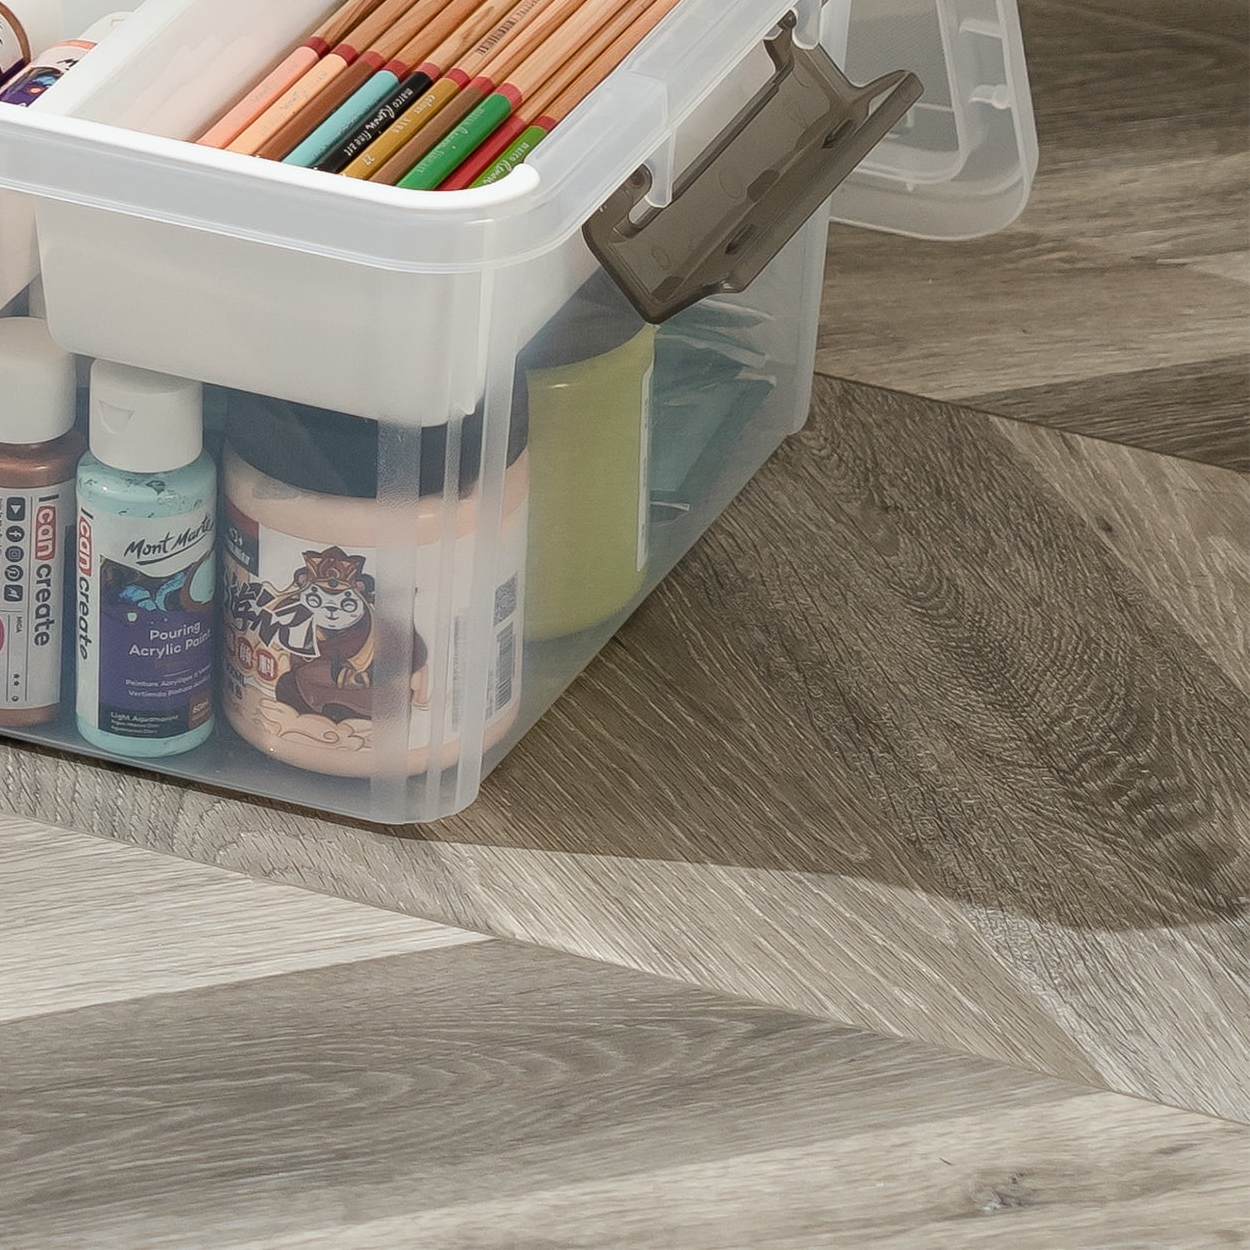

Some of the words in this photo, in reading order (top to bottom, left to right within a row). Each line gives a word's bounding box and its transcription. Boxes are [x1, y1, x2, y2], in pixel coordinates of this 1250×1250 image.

[392, 88, 414, 109] marco
[354, 130, 373, 147] fine
[343, 142, 358, 157] art
[509, 141, 530, 162] marco
[361, 153, 376, 168] 27
[38, 493, 60, 503] I
[81, 507, 94, 520] I
[36, 507, 55, 559] can
[123, 532, 173, 559] Mont
[171, 515, 214, 551] Marte
[79, 523, 91, 568] can
[34, 563, 56, 648] create
[78, 576, 93, 660] create
[150, 622, 201, 641] Pouring
[129, 643, 182, 658] Acrylic
[185, 629, 211, 651] Paint
[126, 679, 159, 687] Peinture
[111, 712, 130, 721] Light
